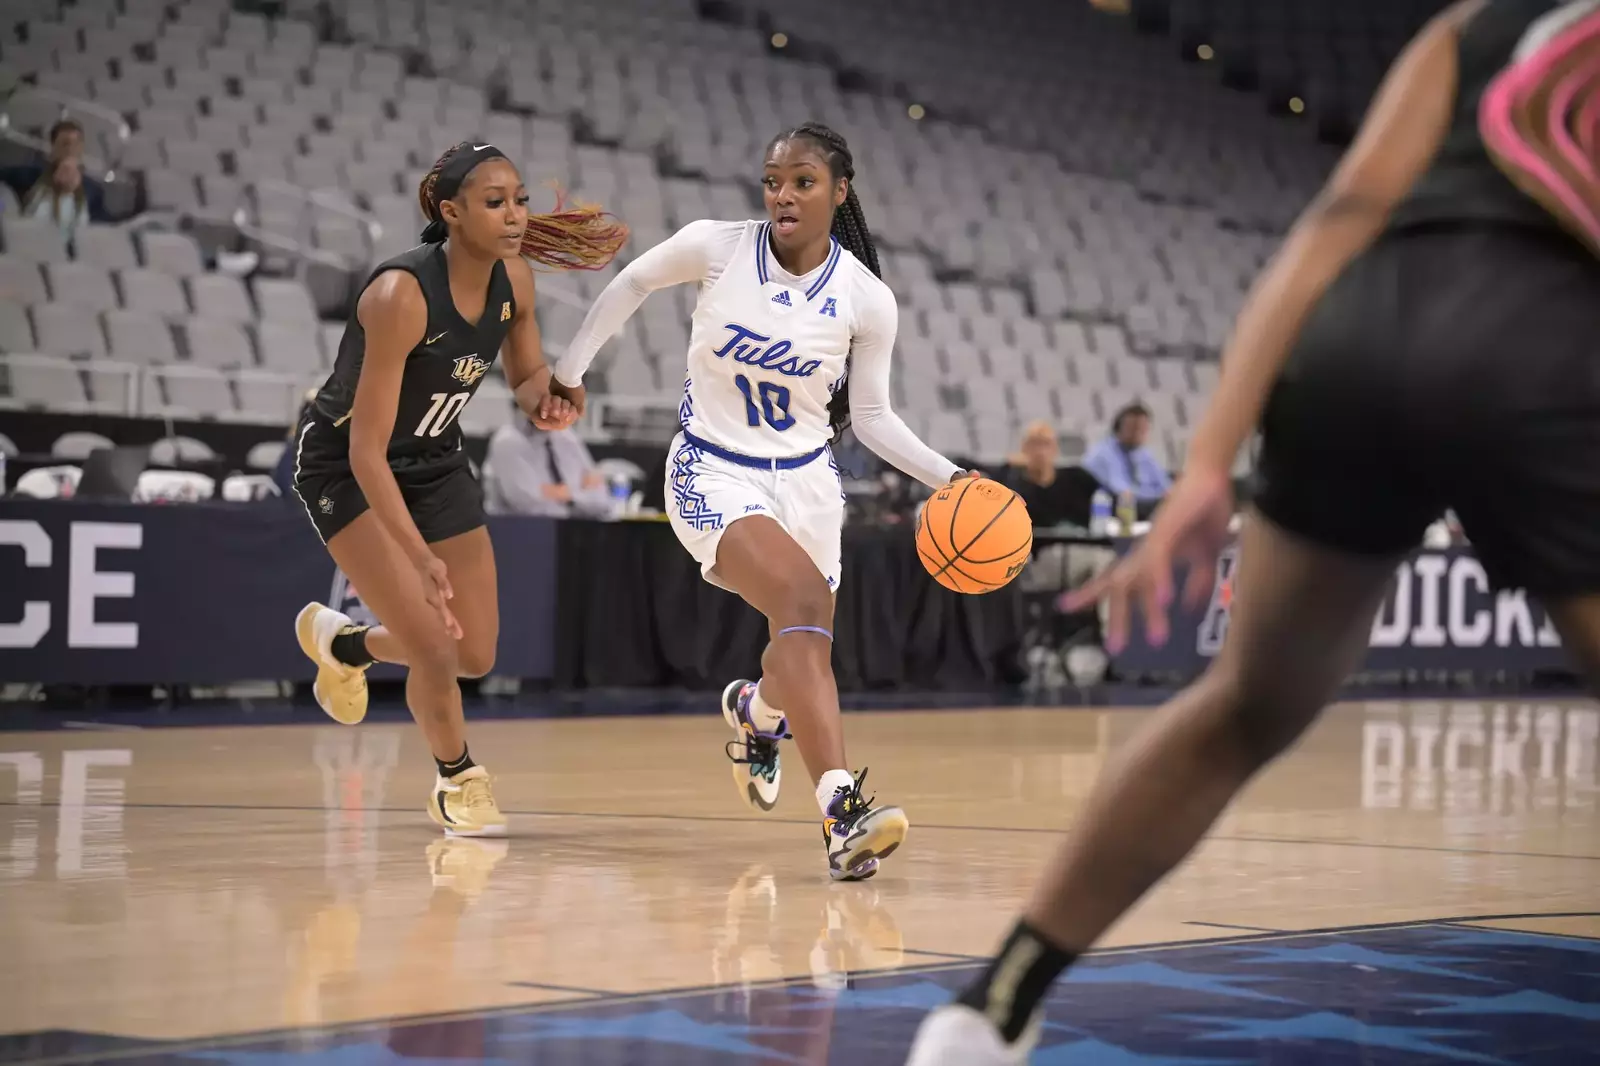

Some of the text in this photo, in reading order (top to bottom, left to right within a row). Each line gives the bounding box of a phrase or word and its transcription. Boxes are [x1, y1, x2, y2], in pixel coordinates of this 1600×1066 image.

[771, 296, 793, 307] adidas
[451, 353, 491, 387] UCF
[713, 323, 823, 377] Tulsa
[414, 392, 471, 438] 10
[735, 374, 796, 432] 10
